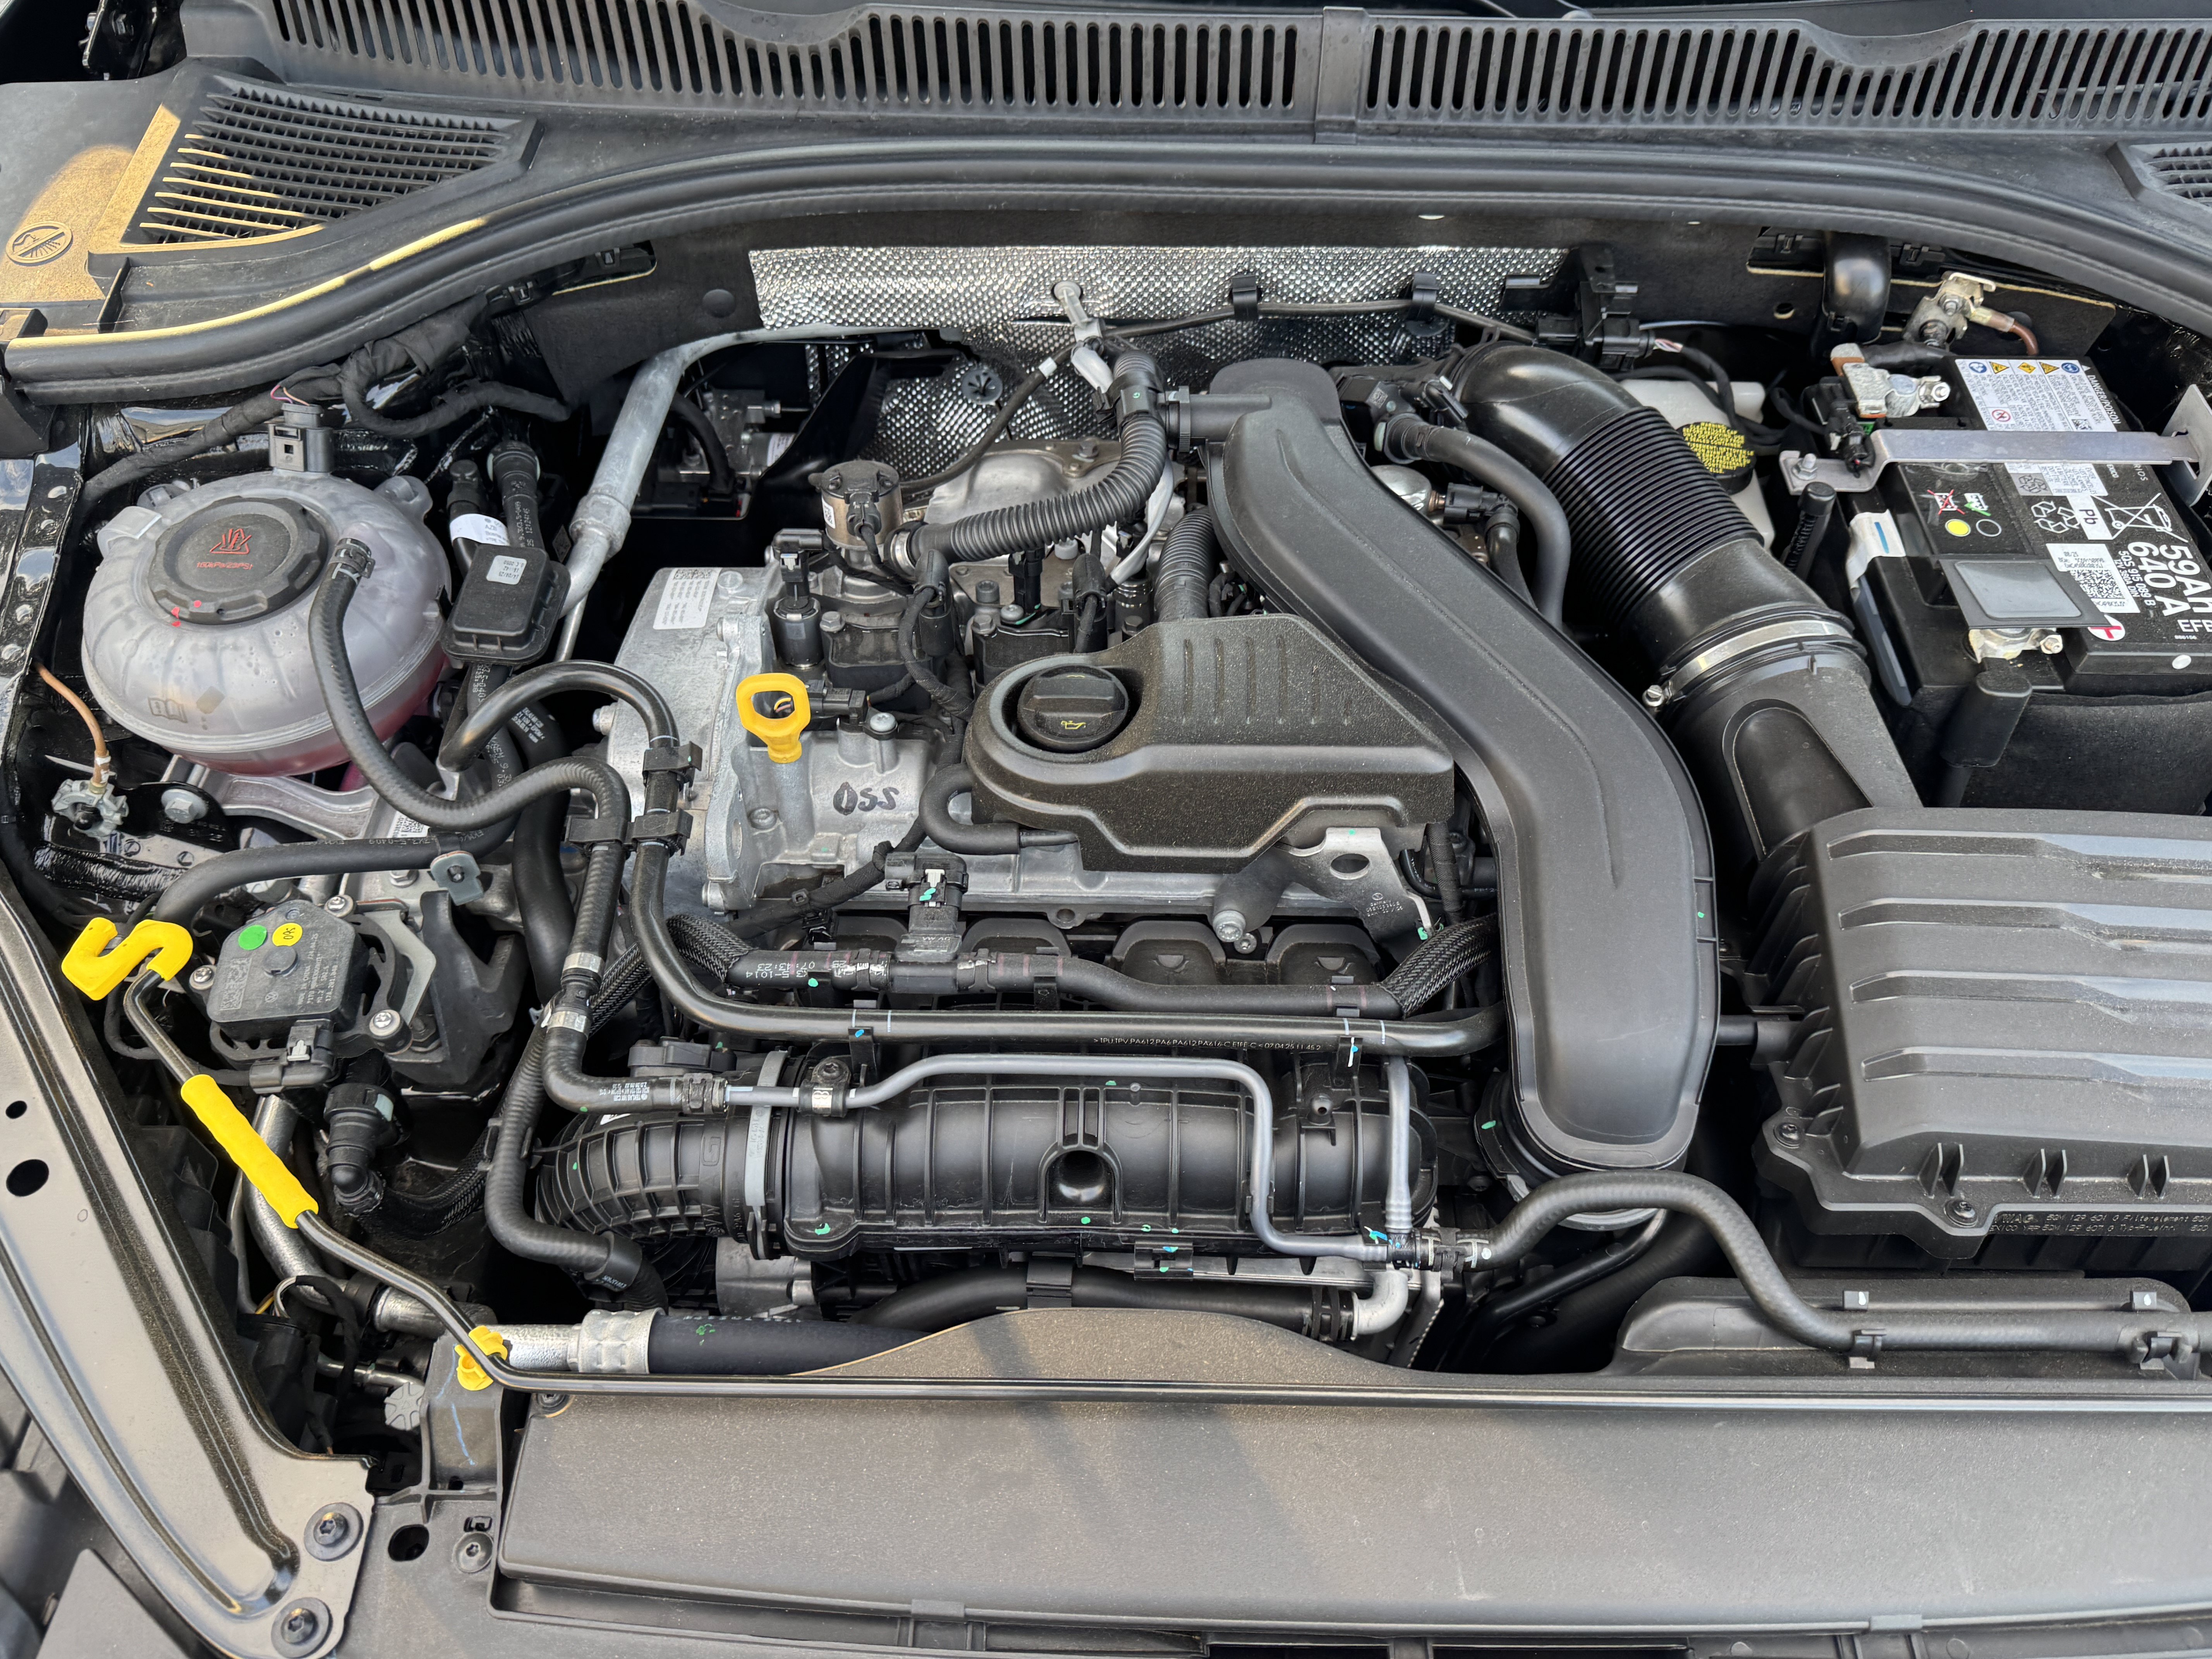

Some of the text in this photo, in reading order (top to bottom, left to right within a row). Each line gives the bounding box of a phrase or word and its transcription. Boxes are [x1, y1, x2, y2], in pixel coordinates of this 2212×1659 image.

[2088, 374, 2121, 424] DANGER/POISON
[2107, 464, 2119, 478] EXICO
[2079, 509, 2096, 525] Pb
[2114, 559, 2125, 570] 12V
[2128, 585, 2140, 598] DIN
[2128, 542, 2191, 616] 640 A
[2128, 568, 2143, 582] 915
[2136, 582, 2152, 599] 089
[2159, 544, 2212, 612] 59Ah
[2177, 619, 2212, 632] EFB
